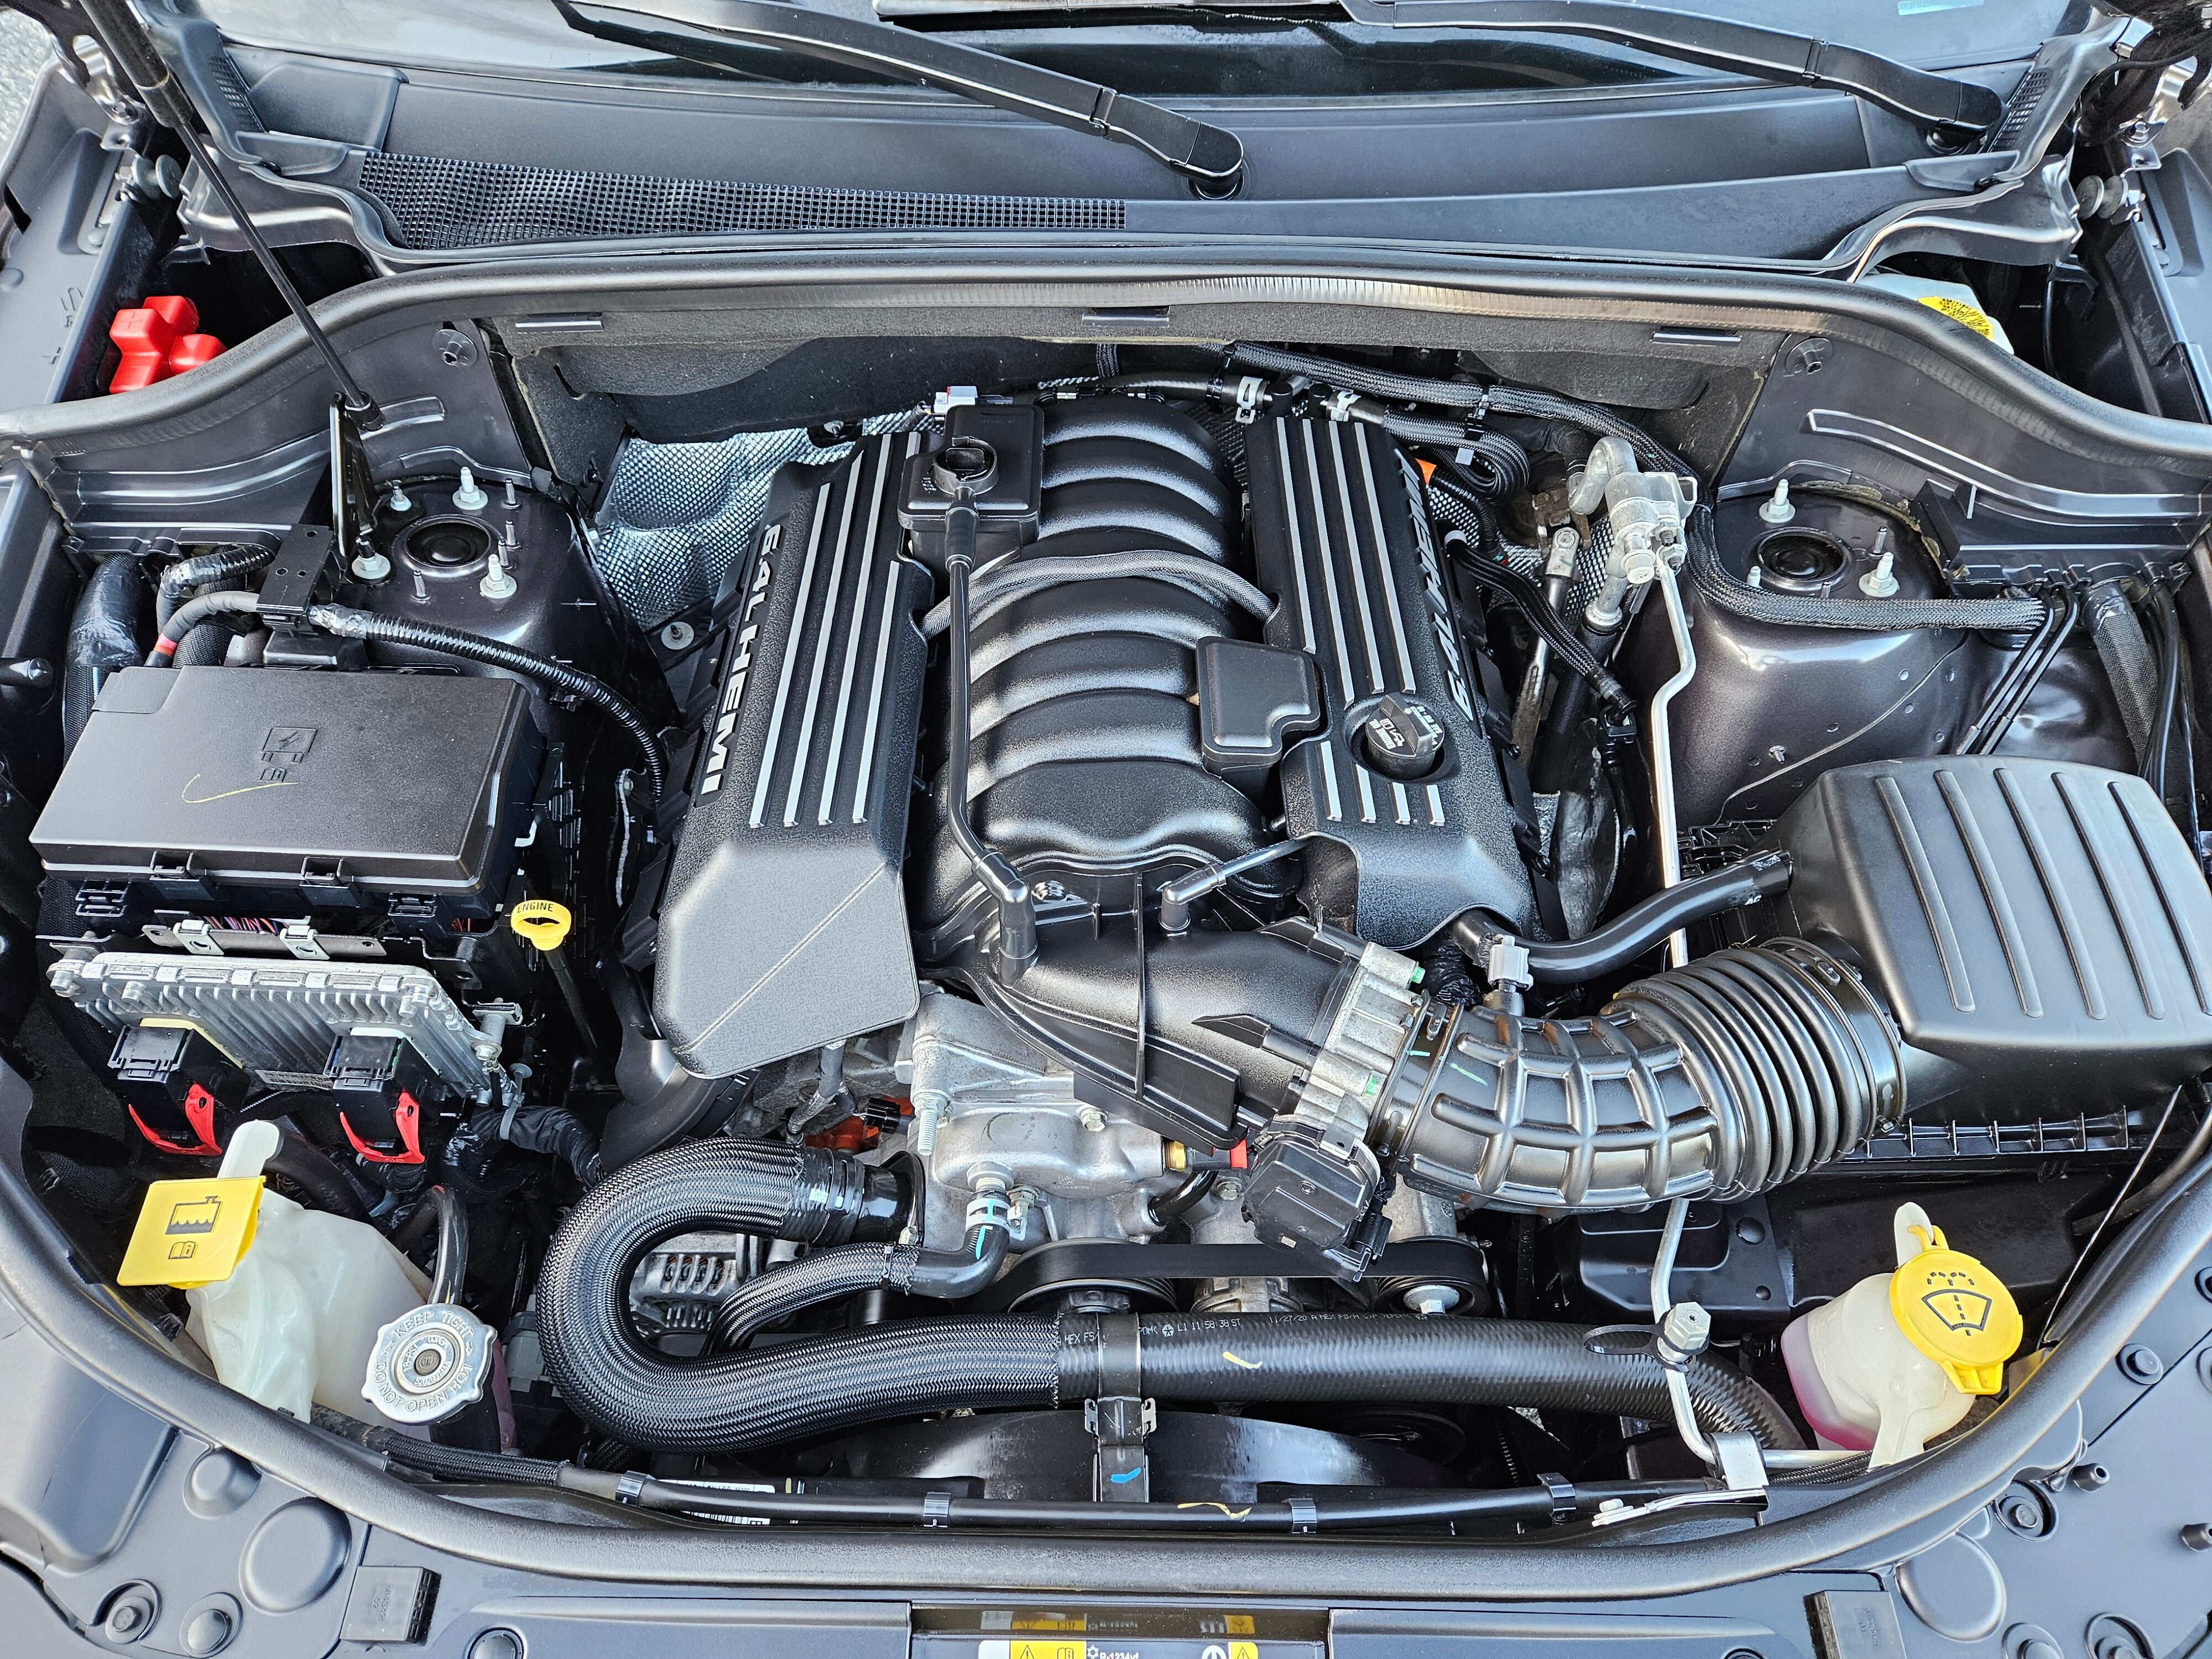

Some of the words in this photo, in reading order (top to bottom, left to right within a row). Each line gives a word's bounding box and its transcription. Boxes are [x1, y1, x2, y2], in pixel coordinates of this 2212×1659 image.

[1394, 448, 1448, 613] HEMI
[745, 524, 781, 623] 6.4L
[1434, 612, 1474, 721] 6.4L
[701, 624, 759, 795] HEMI
[1369, 718, 1381, 729] OIL
[1375, 728, 1396, 750] ENGINE
[517, 902, 554, 914] ENGINE
[1745, 895, 1762, 905] AC
[392, 1311, 434, 1338] KEEP
[442, 1310, 474, 1338] TIGHT
[1065, 1333, 1080, 1344] MEX
[1084, 1332, 1098, 1342] FS/
[1192, 1318, 1229, 1331] 11:58:38
[1230, 1318, 1241, 1327] ST
[1269, 1314, 1308, 1323] 11/27/20
[374, 1362, 386, 1383] DO
[448, 1363, 473, 1394] HOT
[378, 1383, 404, 1408] NOT
[405, 1390, 448, 1412] OPEN
